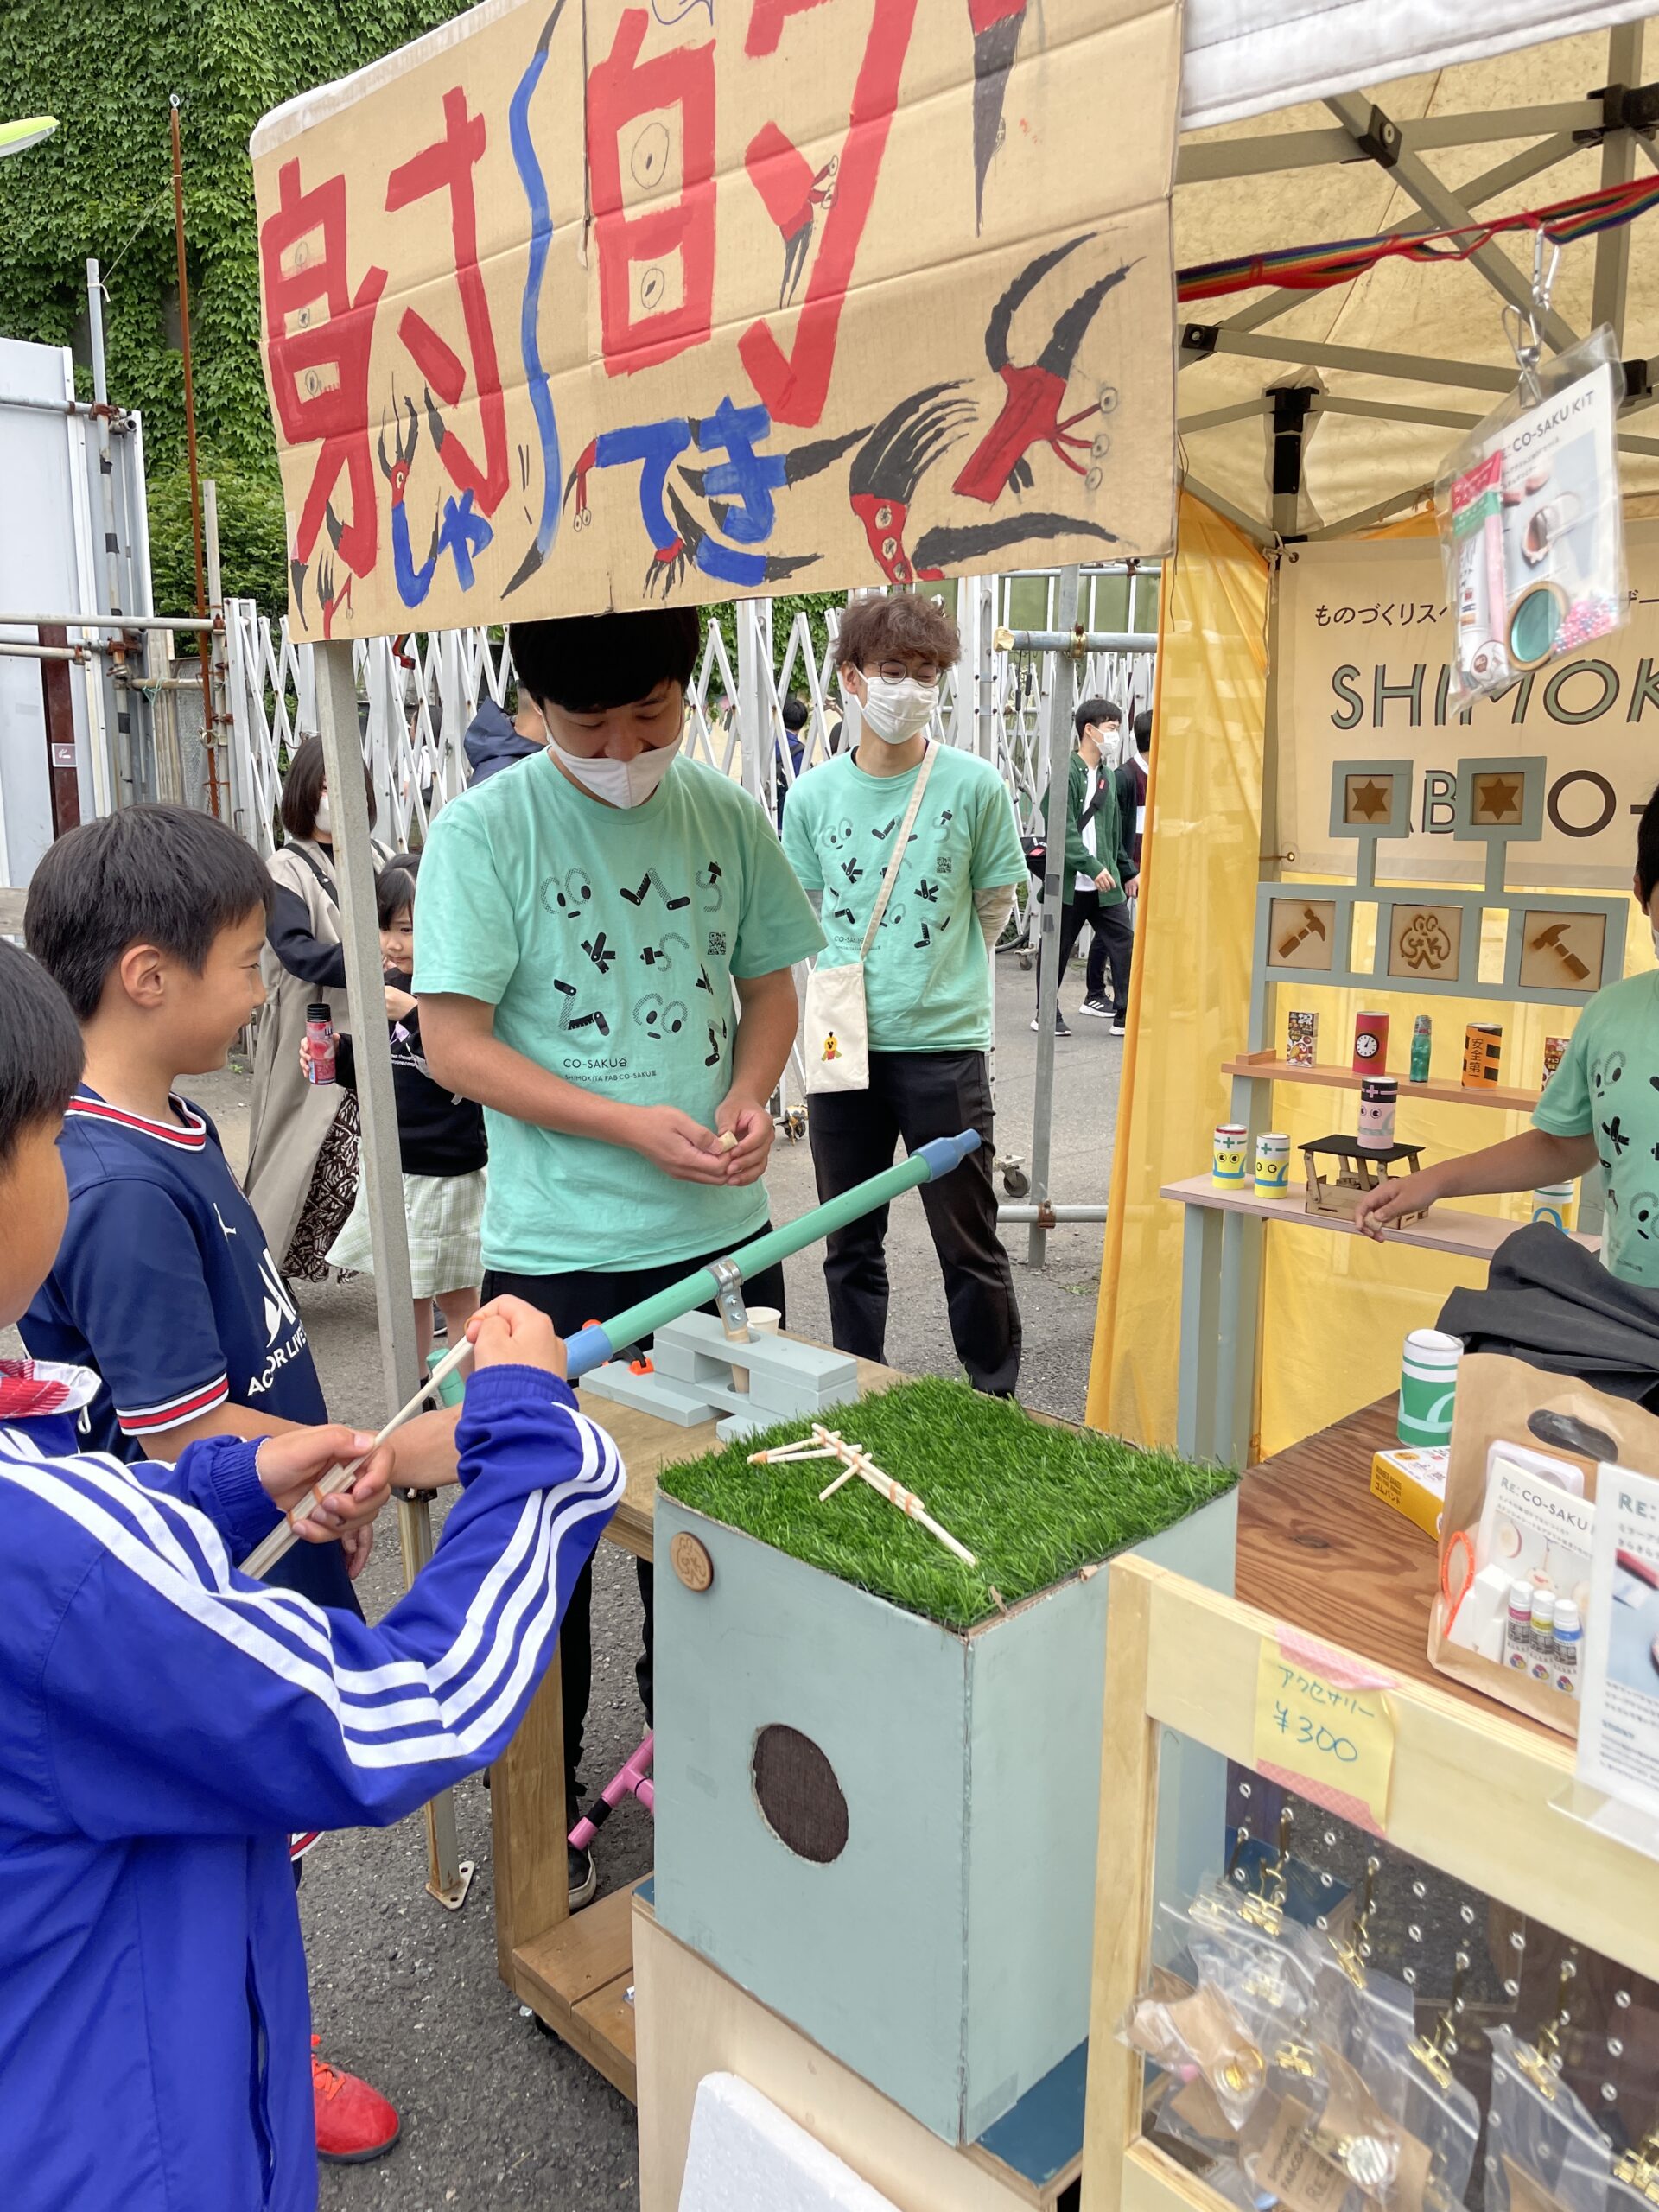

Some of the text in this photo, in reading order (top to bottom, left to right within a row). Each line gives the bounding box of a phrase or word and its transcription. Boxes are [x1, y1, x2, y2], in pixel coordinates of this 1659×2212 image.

[1513, 404, 1569, 452] CO-SAKU
[1572, 391, 1594, 415] KIT
[1469, 1038, 1484, 1077] 安全第一
[565, 1073, 603, 1083] SHIMOKITA
[1522, 1490, 1588, 1531] CO-SAKU
[1618, 1491, 1657, 1521] RE:
[1278, 1664, 1375, 1718] アクセサリー
